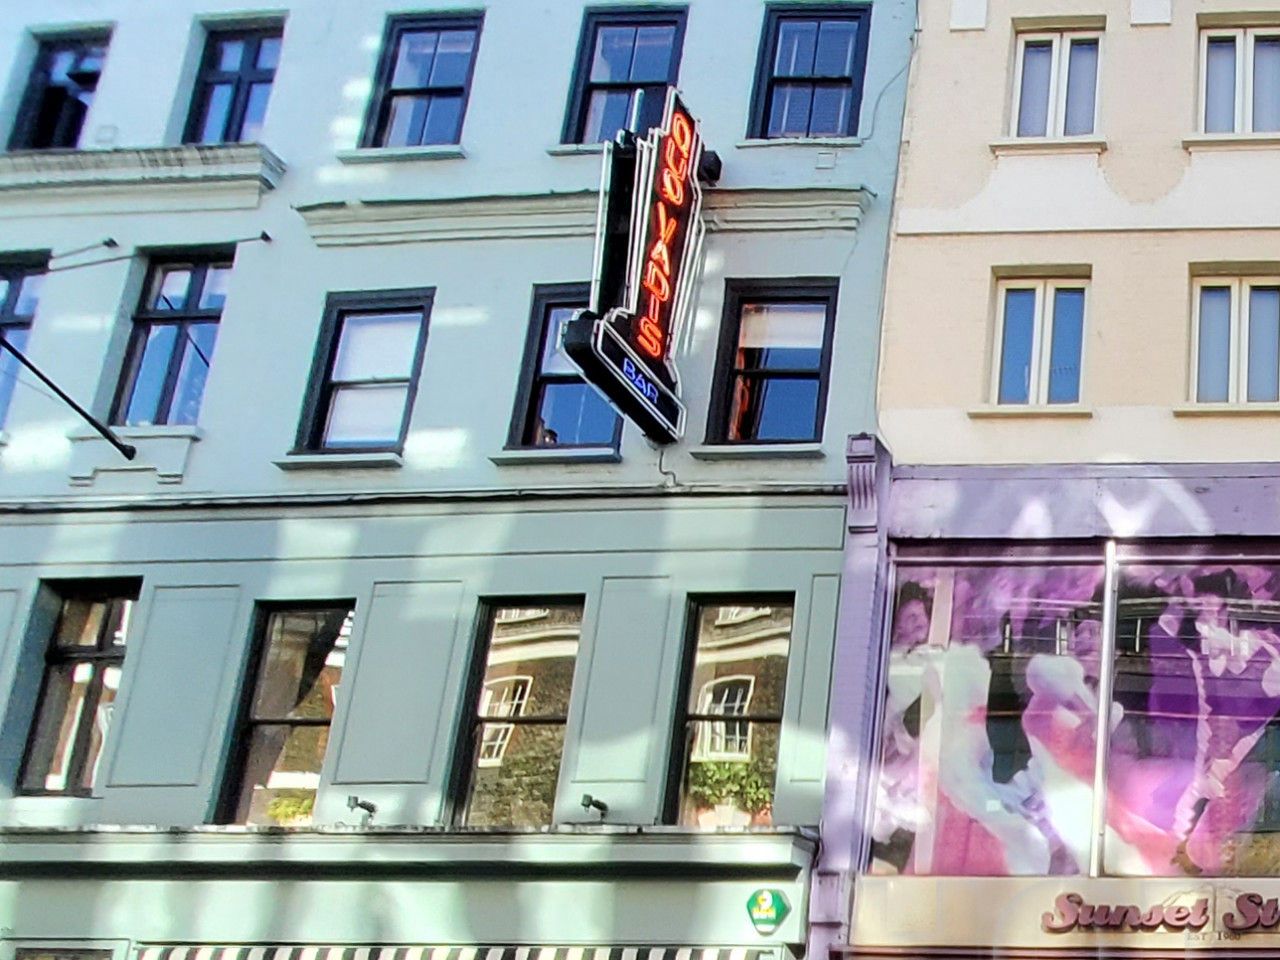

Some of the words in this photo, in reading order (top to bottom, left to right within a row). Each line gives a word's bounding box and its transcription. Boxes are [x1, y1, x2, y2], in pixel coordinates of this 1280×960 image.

[661, 111, 692, 206] QUO
[637, 201, 677, 357] VADIS
[623, 357, 660, 404] BAR
[1041, 892, 1210, 933] Sunset
